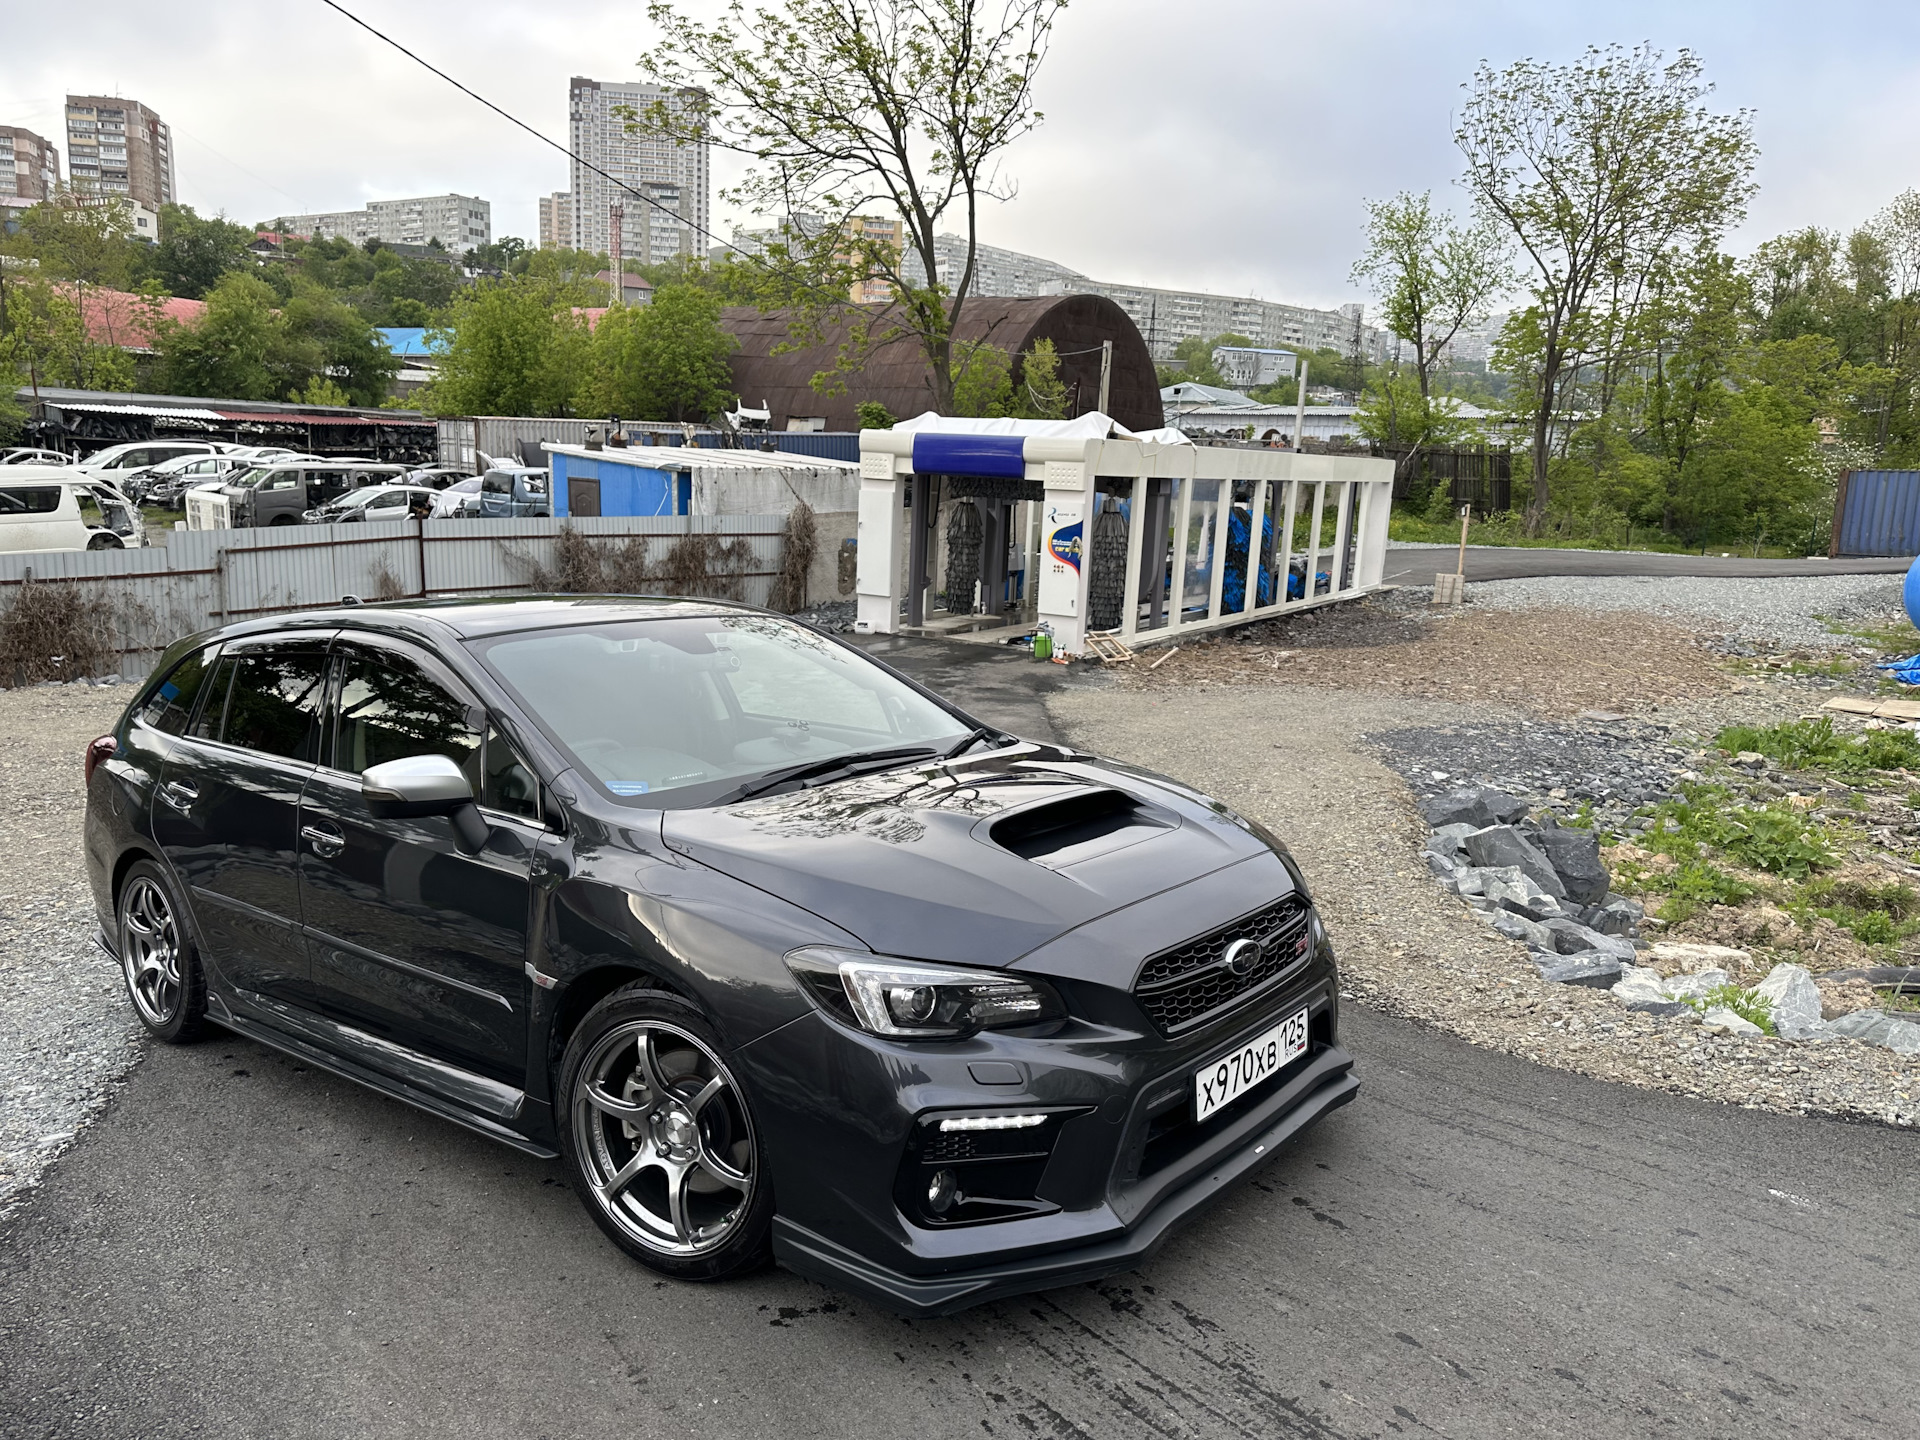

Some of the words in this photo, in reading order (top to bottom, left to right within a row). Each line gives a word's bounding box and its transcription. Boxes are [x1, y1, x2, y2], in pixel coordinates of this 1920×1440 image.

[1202, 1040, 1277, 1112] Х970ХВ
[1280, 1012, 1305, 1050] 125
[1284, 1043, 1298, 1060] RUS
[594, 1130, 612, 1170] ADVAN
